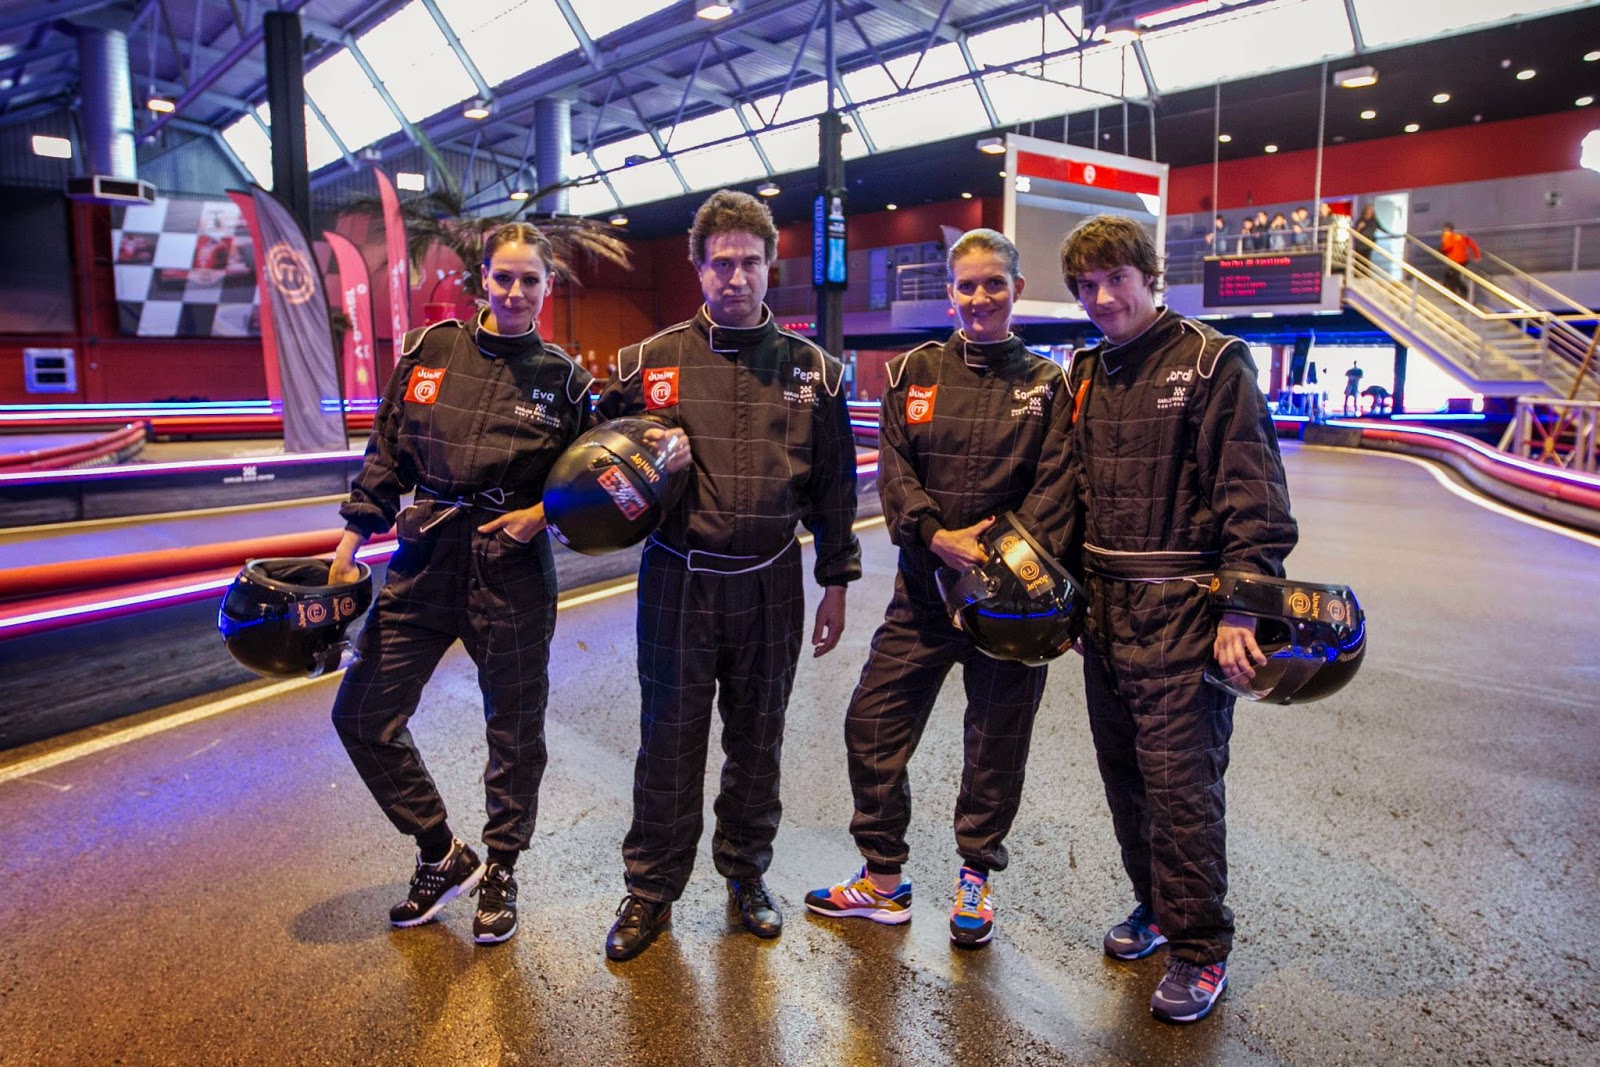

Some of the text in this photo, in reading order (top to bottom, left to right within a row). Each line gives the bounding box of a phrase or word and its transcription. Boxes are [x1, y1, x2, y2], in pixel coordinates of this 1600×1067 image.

[793, 367, 820, 383] Pepe
[532, 388, 555, 403] Eva
[630, 453, 660, 484] Junior
